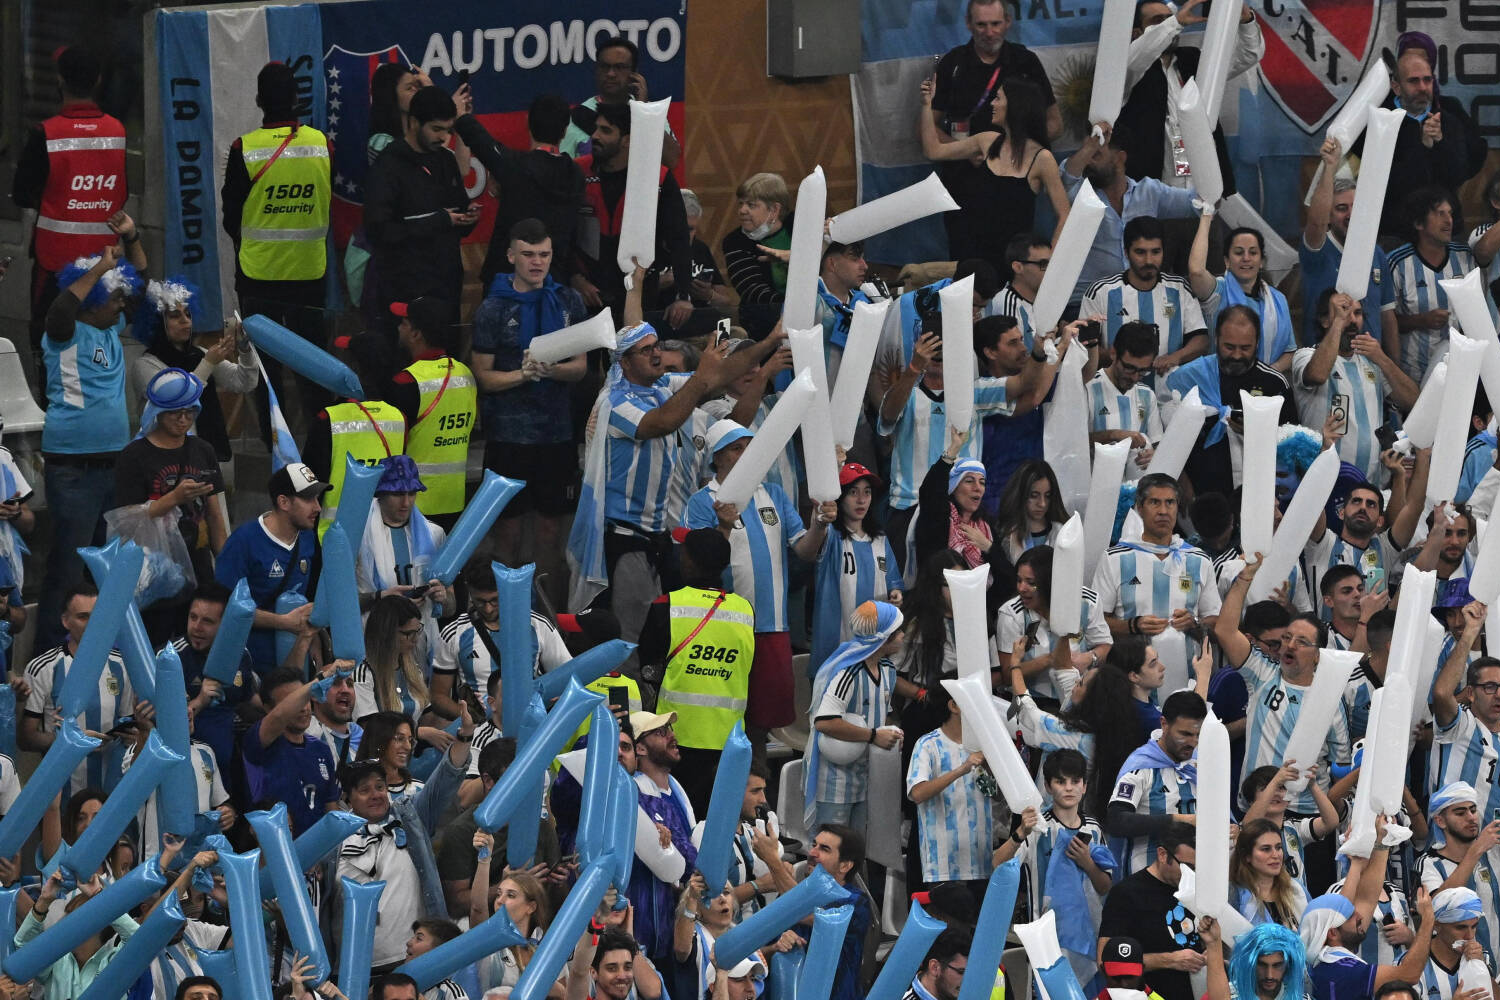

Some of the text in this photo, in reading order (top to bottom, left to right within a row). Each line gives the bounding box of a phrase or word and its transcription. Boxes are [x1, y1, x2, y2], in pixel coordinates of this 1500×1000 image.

[71, 174, 117, 190] 0314
[264, 184, 315, 200] 1508
[67, 198, 113, 211] Security
[263, 203, 315, 216] Security
[434, 434, 469, 447] Securit
[689, 644, 739, 664] 3846
[685, 662, 733, 681] Security
[1264, 684, 1285, 712] 18
